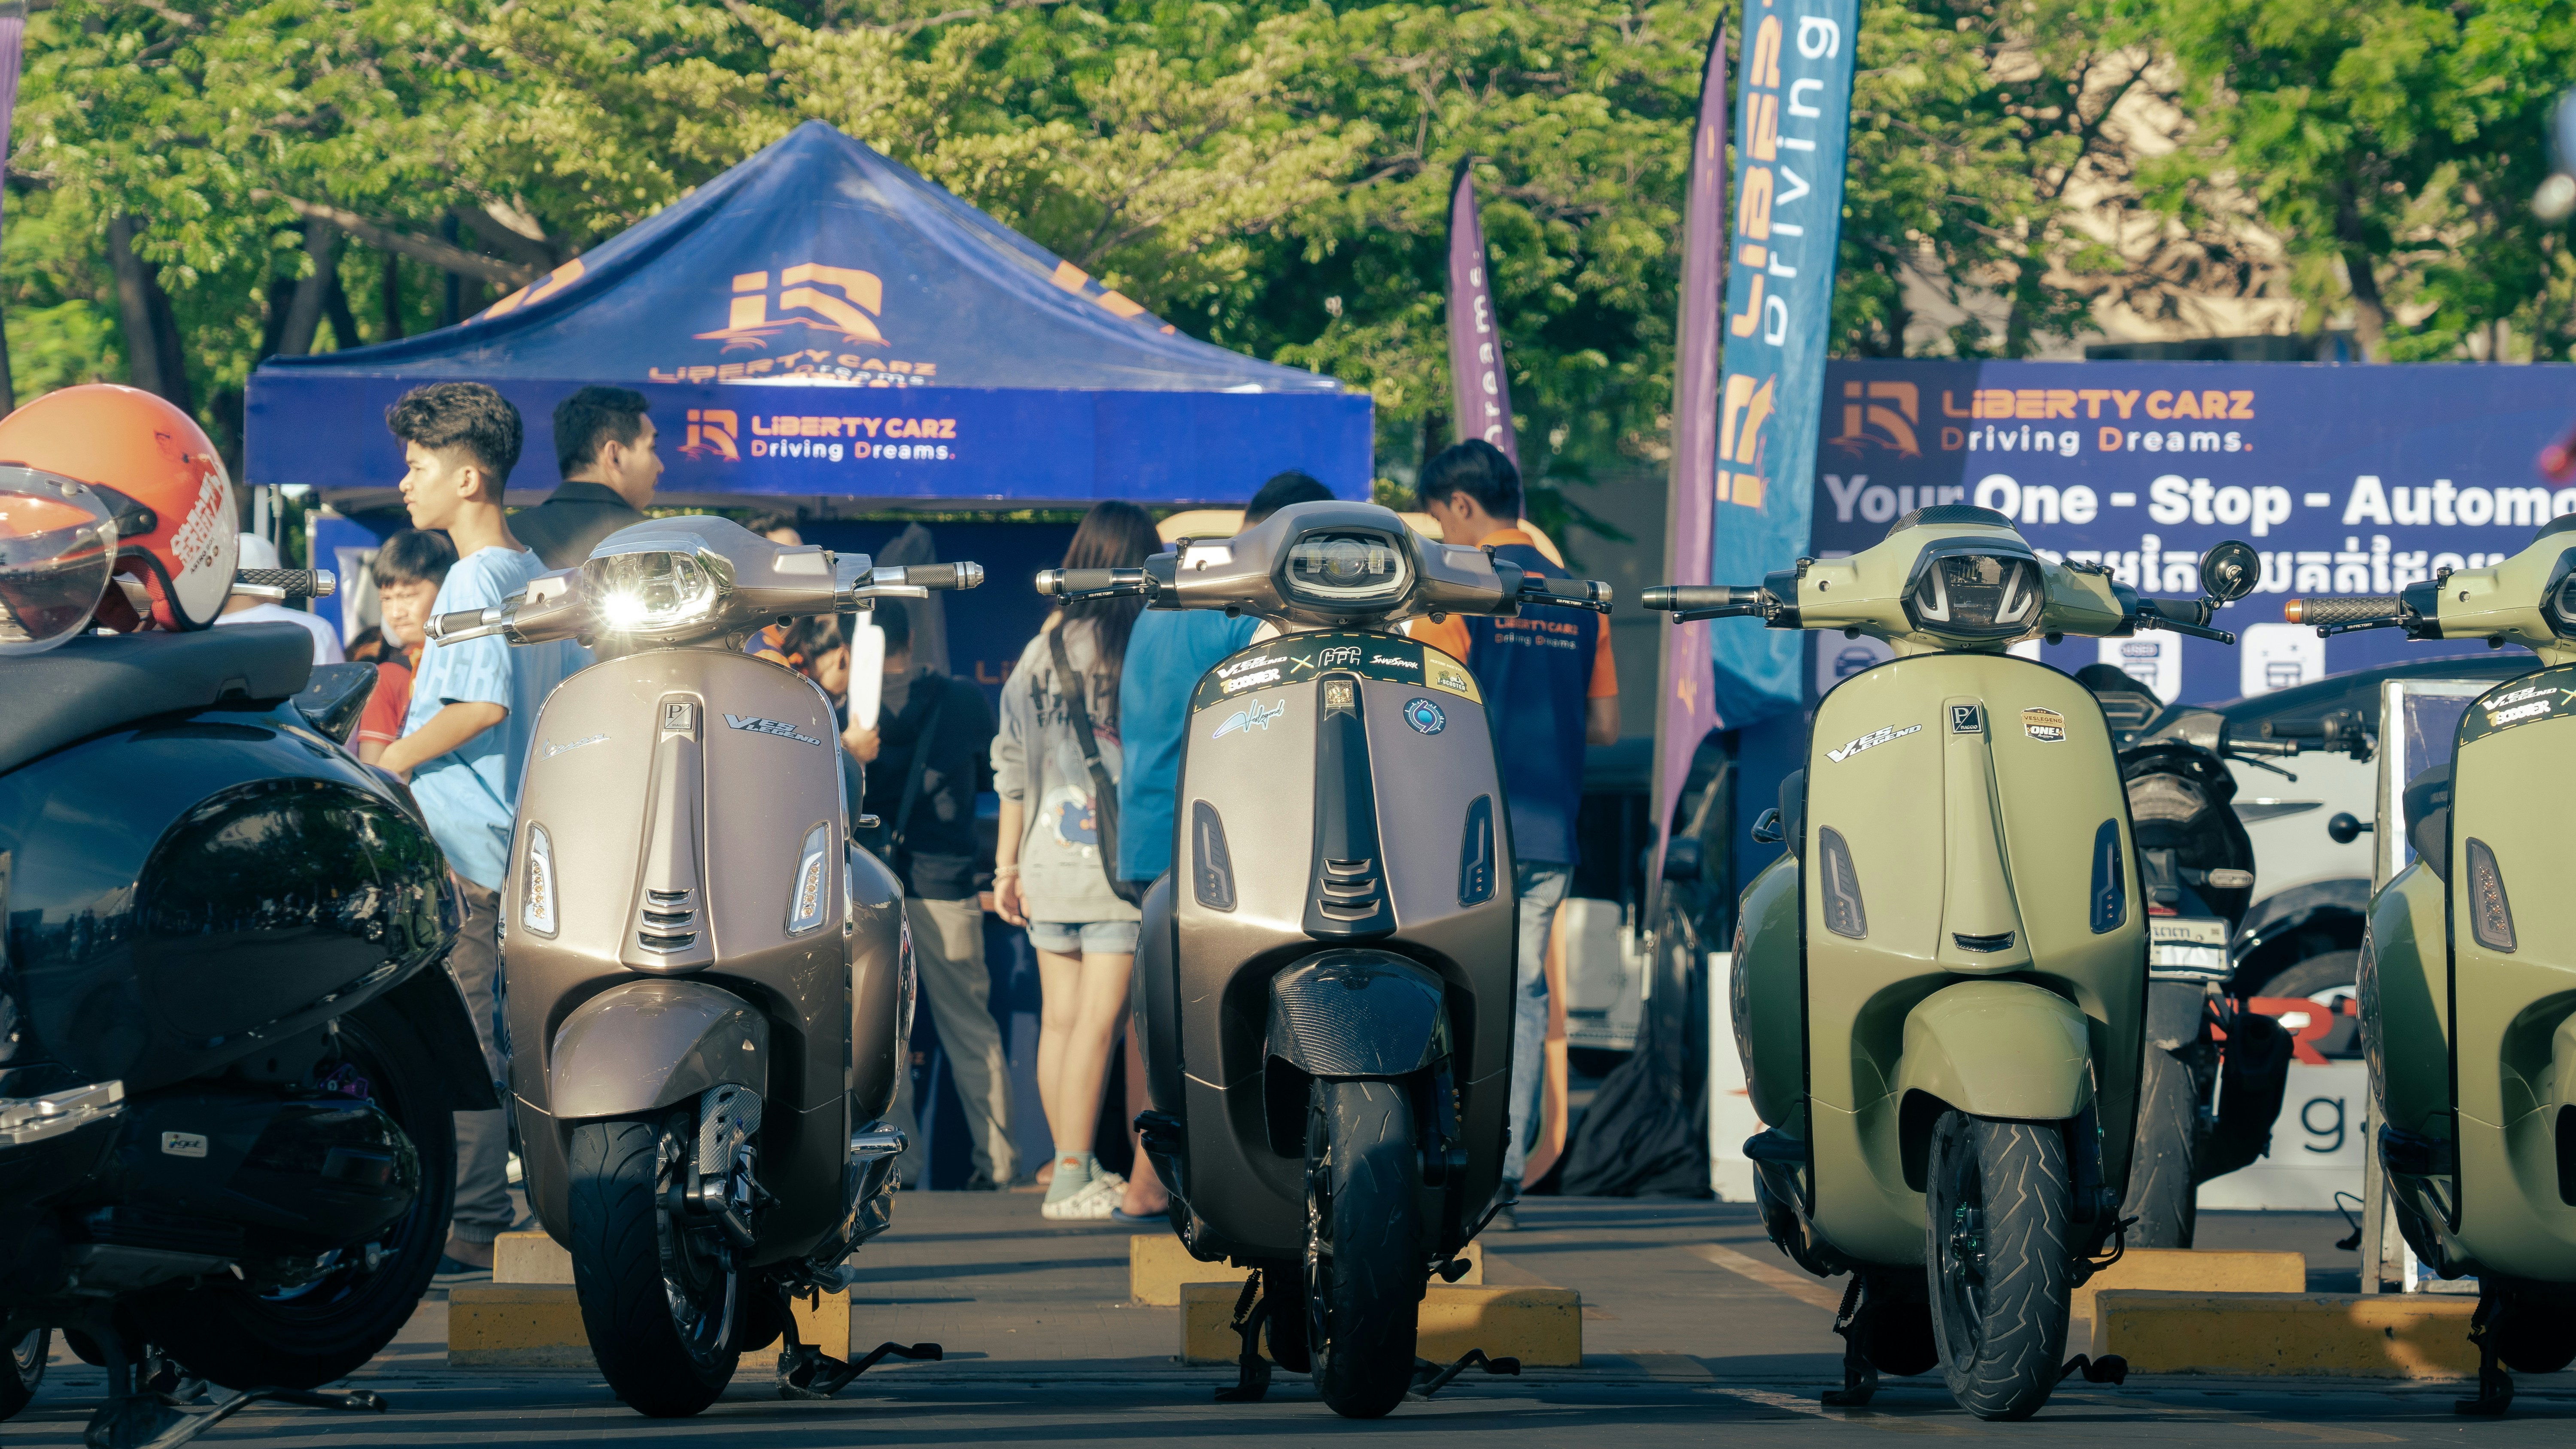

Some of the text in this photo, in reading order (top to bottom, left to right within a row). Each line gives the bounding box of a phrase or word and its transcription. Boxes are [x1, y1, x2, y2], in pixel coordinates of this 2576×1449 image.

[1764, 15, 1841, 347] Driving
[837, 354, 937, 375] CARZ
[2146, 390, 2254, 419] CARZ
[885, 418, 956, 439] CARZ
[1941, 425, 2253, 457] Driving Dreams.
[751, 439, 955, 462] Driving Dreams.
[1975, 474, 2098, 524] One
[2148, 475, 2292, 537] Stop
[2499, 688, 2557, 706] LEGEND
[540, 733, 611, 762] Vespa
[748, 725, 821, 746] LEGEND
[1850, 724, 1922, 756] LEGEND
